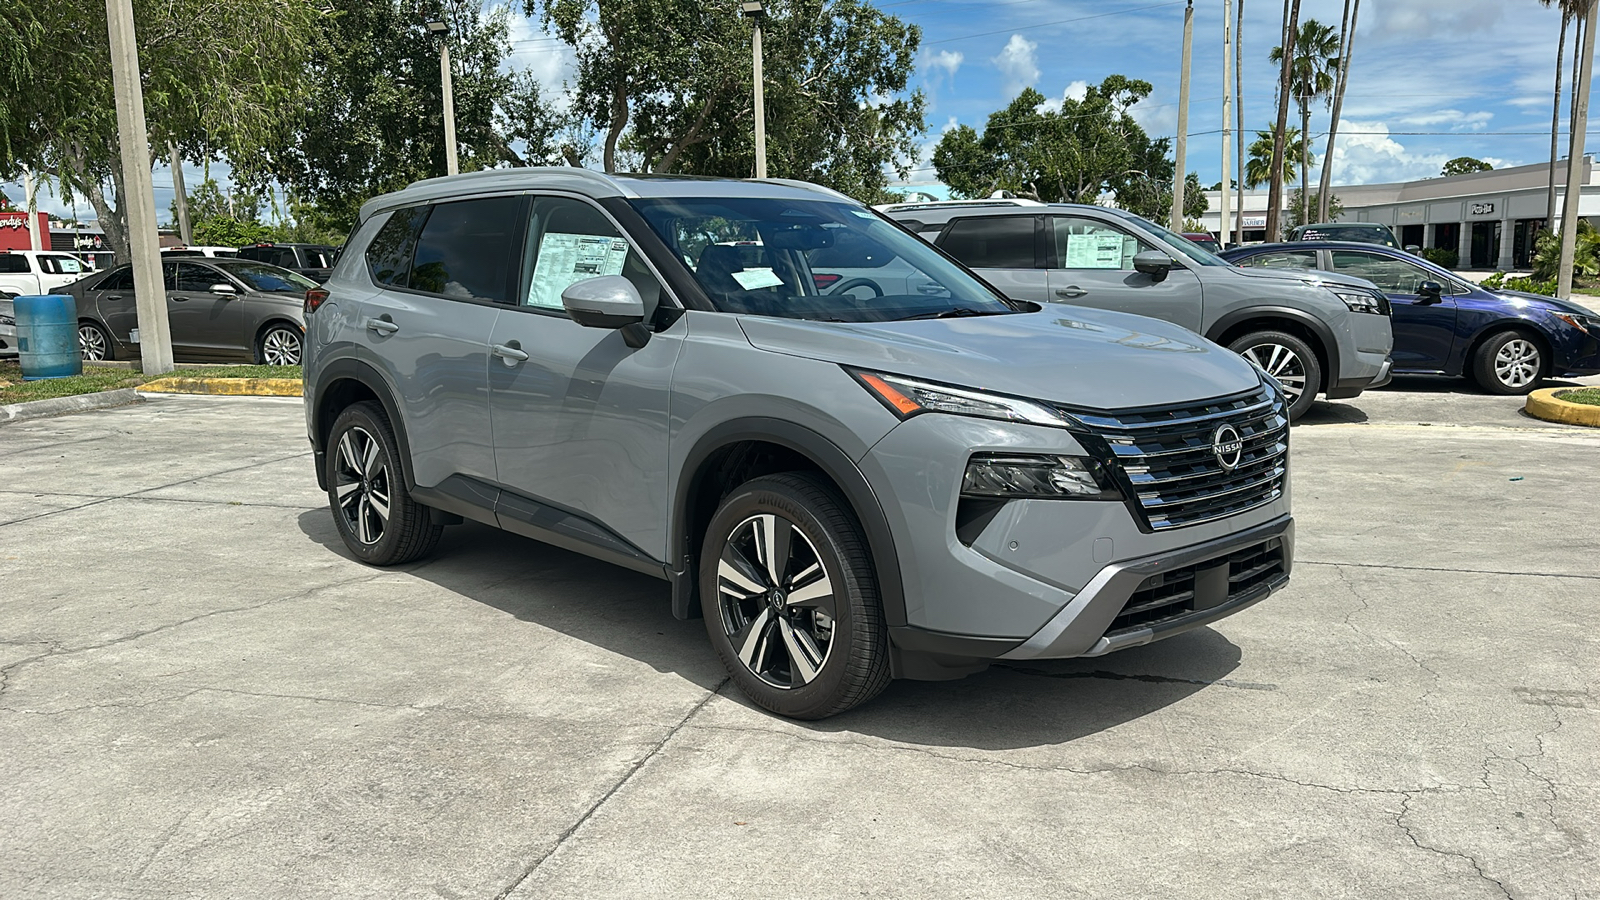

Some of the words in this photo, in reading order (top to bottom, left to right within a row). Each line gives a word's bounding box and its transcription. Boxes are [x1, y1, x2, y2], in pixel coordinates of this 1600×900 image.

[0, 215, 22, 229] endy's
[1214, 442, 1242, 454] NISSAN
[757, 492, 830, 552] BRIDGESTONE
